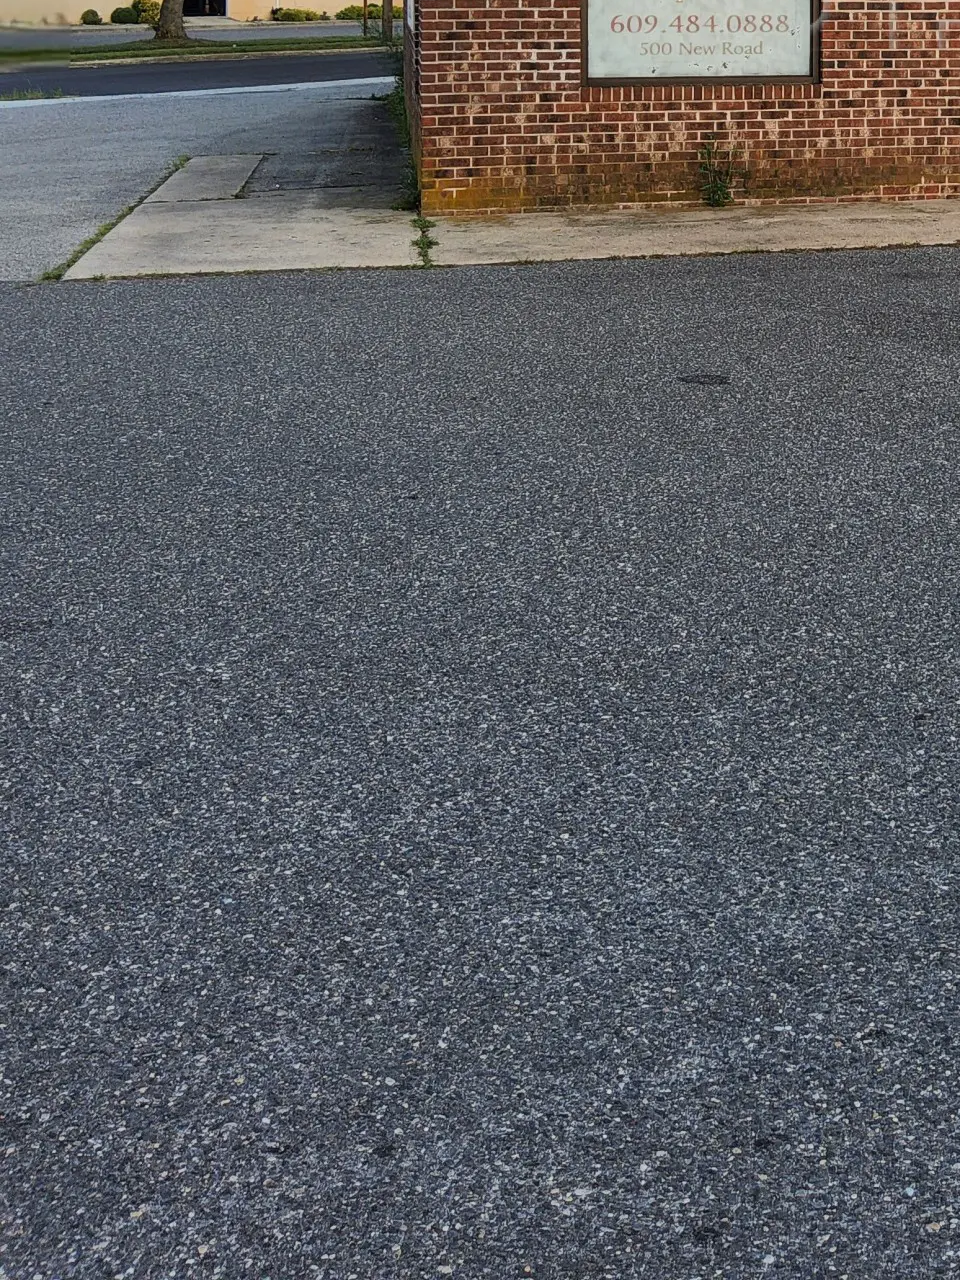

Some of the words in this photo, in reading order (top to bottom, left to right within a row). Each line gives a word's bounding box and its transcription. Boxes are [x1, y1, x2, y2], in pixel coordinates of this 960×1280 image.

[610, 14, 790, 34] 609.484.0888
[639, 42, 672, 56] 500
[679, 42, 715, 56] New
[722, 41, 764, 56] Road
